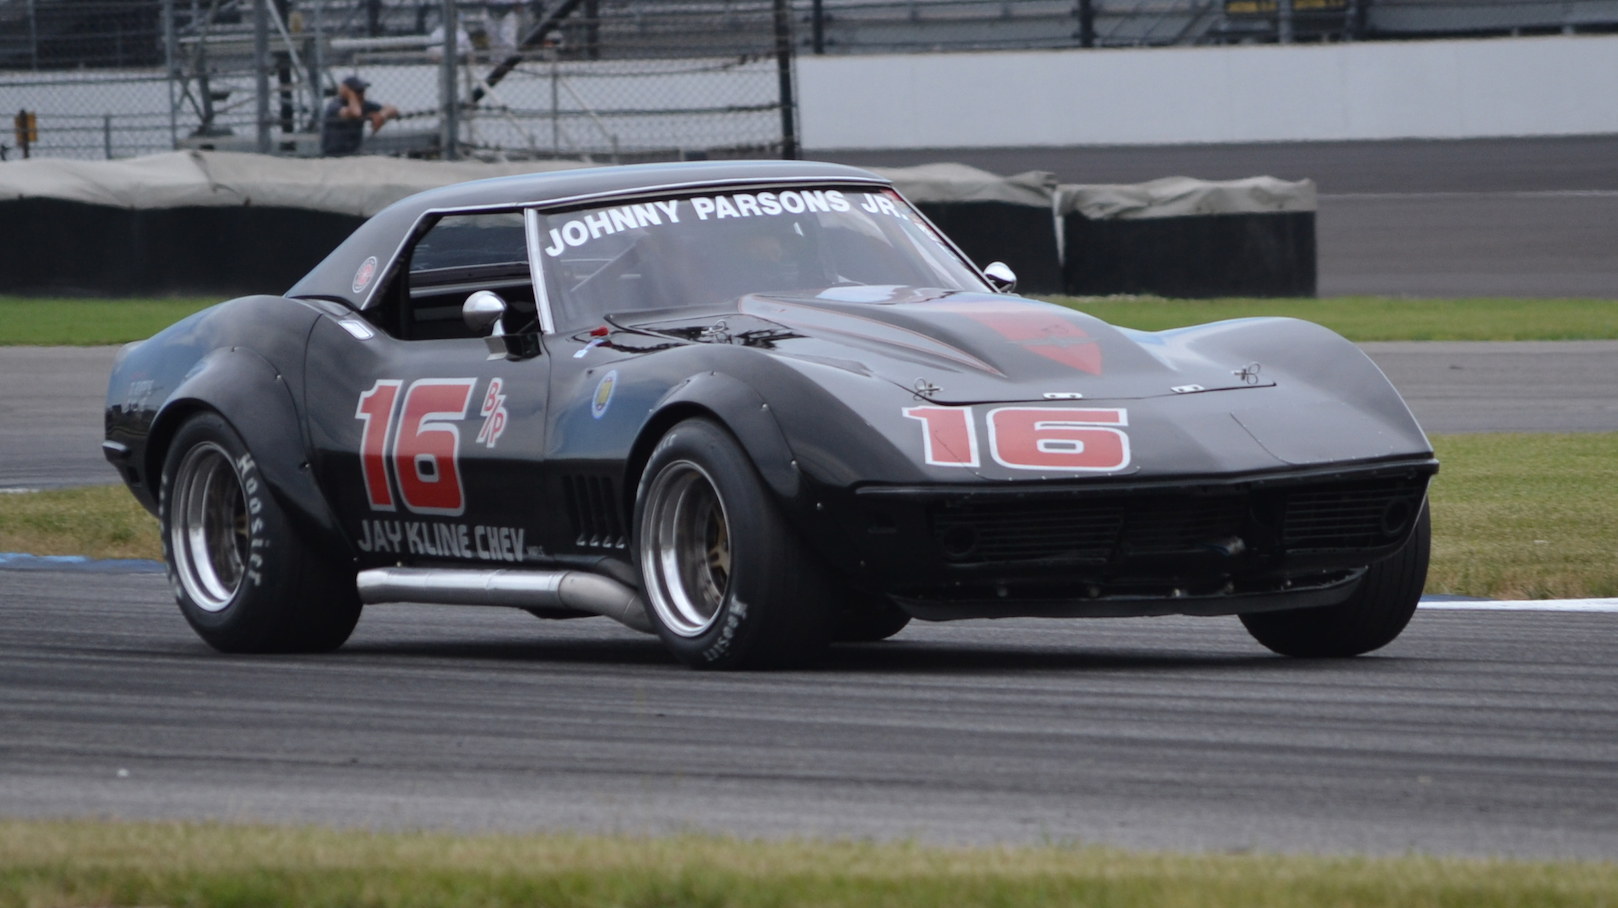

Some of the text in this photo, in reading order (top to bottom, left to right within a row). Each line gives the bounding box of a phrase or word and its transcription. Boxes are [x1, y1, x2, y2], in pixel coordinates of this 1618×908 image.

[544, 190, 909, 257] JOHNNY PARSONS JR.
[355, 377, 477, 516] 16
[902, 405, 1131, 471] 16
[357, 520, 524, 562] JAY KLINE CHEV
